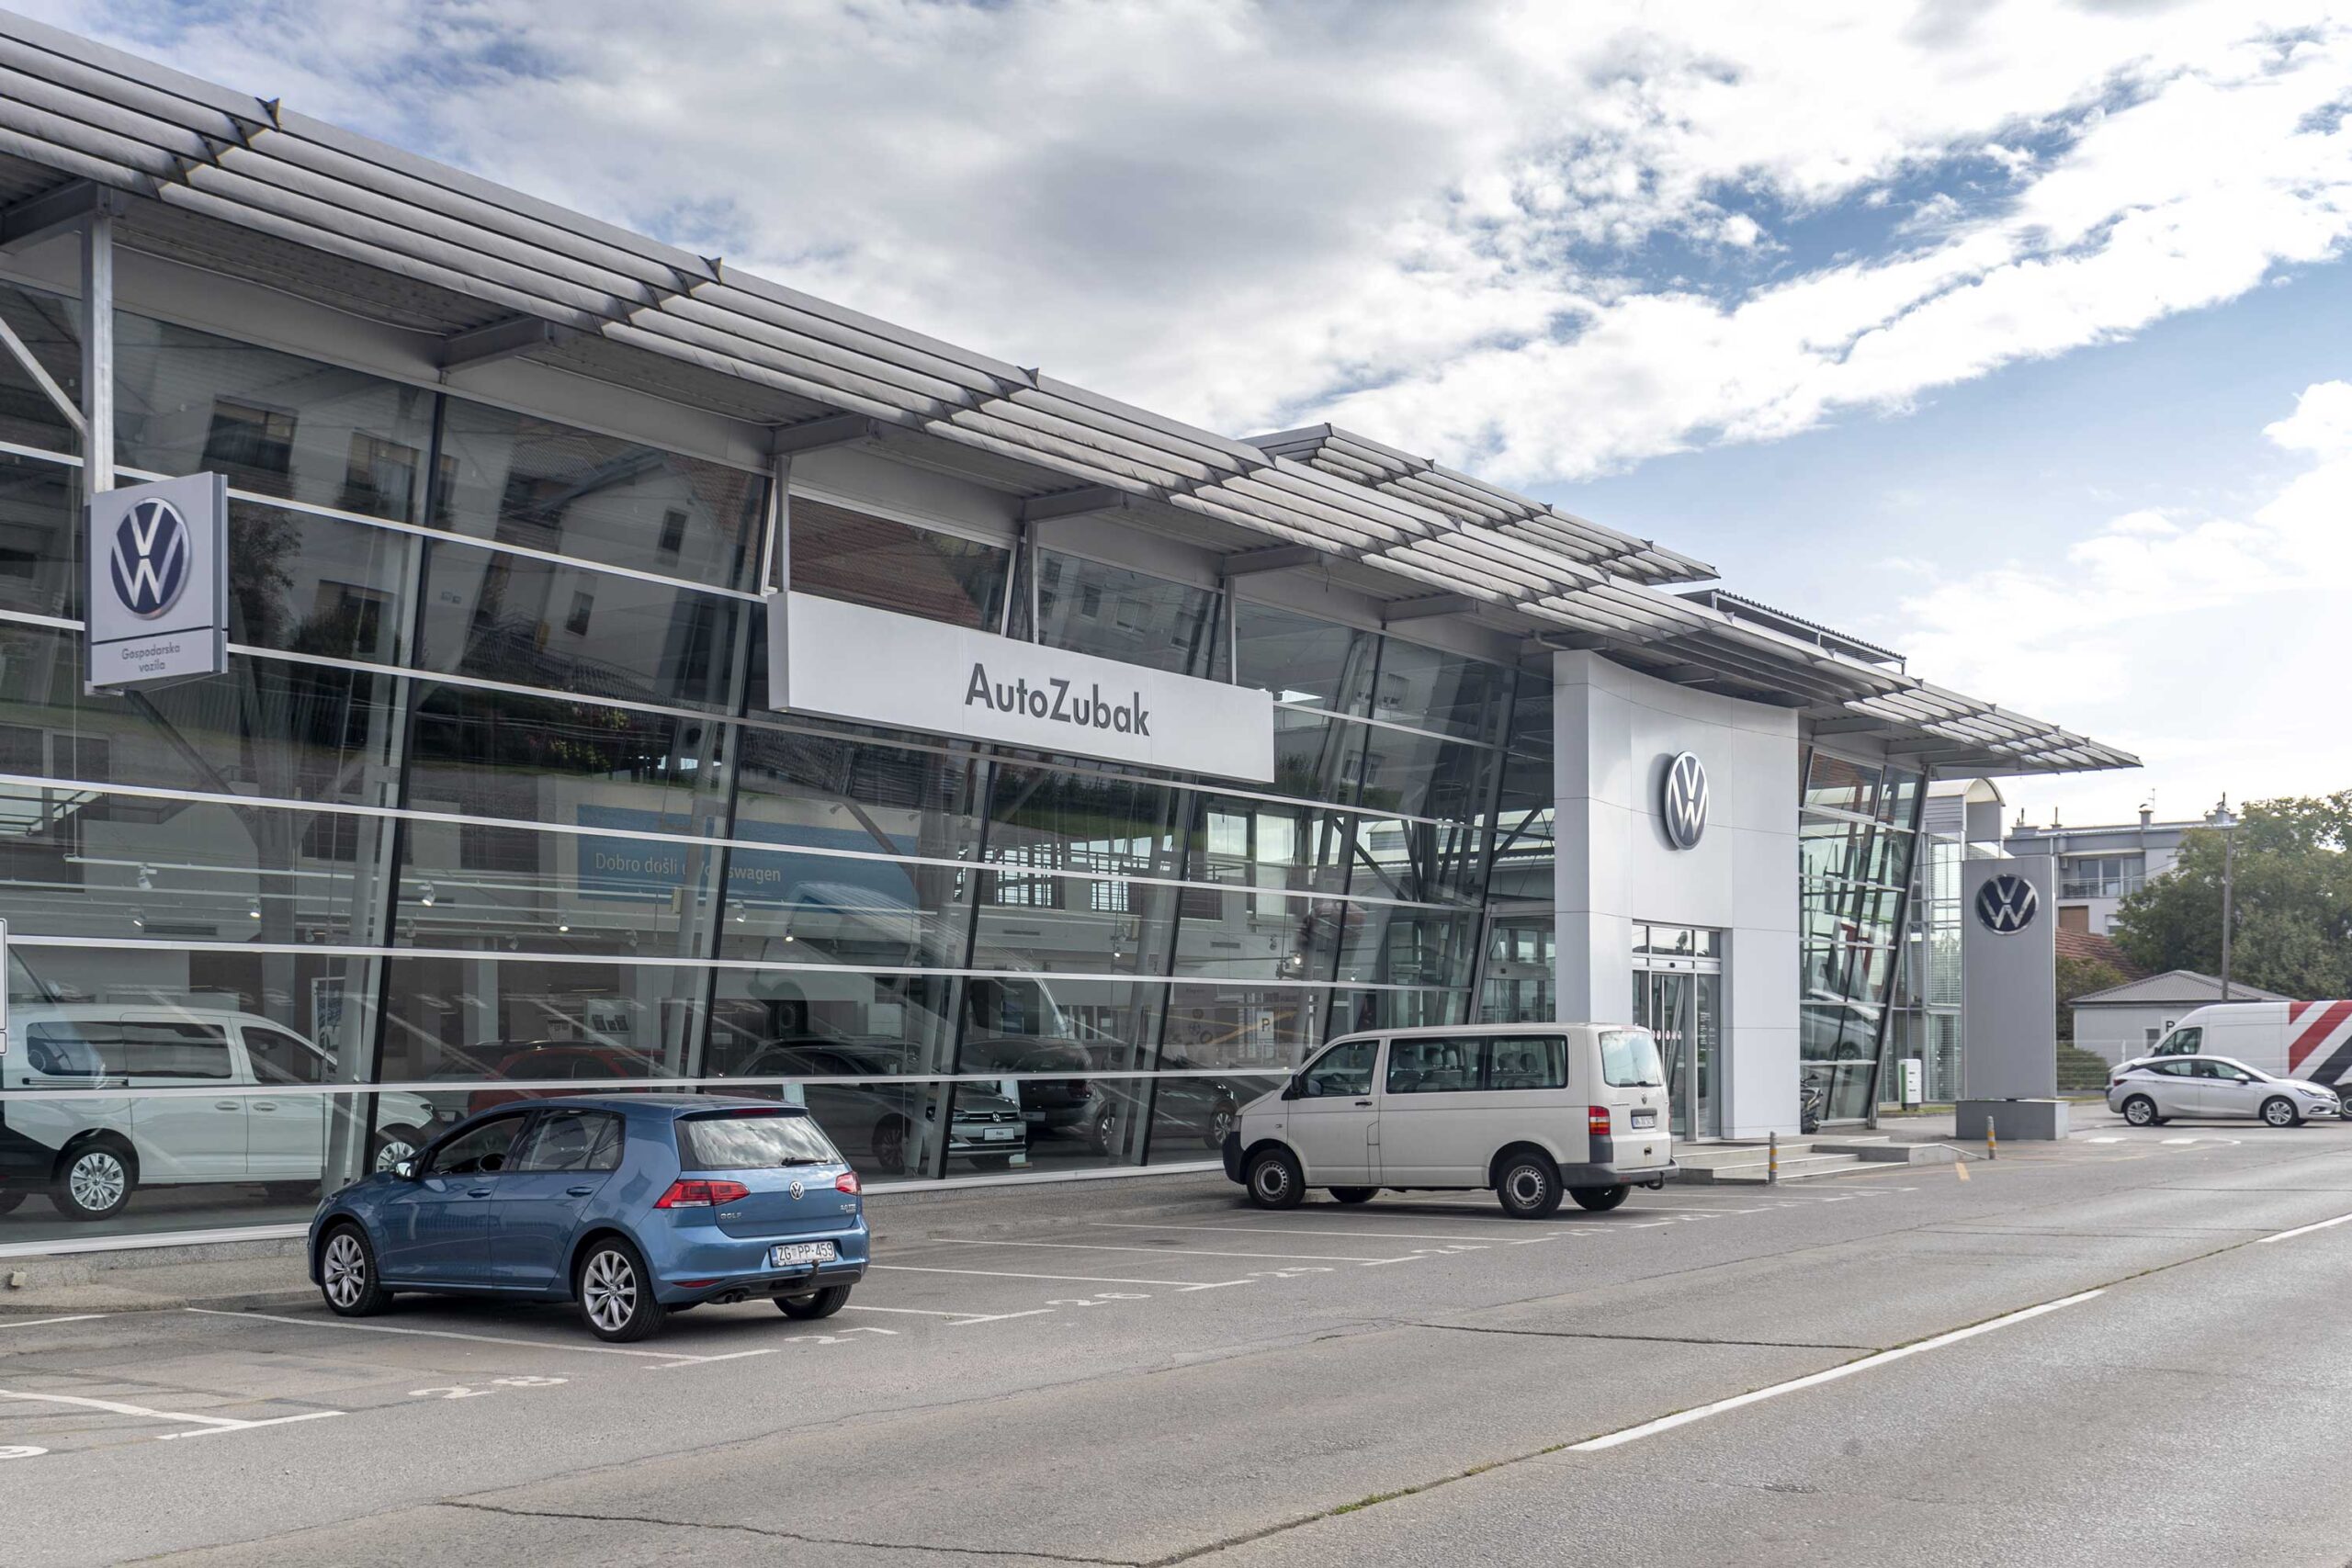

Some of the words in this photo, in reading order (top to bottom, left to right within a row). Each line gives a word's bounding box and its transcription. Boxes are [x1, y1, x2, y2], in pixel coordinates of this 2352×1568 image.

[111, 499, 189, 610] VW
[121, 642, 181, 660] Gospodarska
[139, 660, 165, 672] vozila
[965, 662, 1150, 736] AutoZubak
[1668, 753, 1709, 841] VW
[595, 852, 640, 872] Dobro
[644, 855, 677, 874] došli
[1978, 875, 2037, 930] VW
[1261, 1017, 1271, 1032] P
[778, 1247, 792, 1261] ZG
[1045, 1292, 1152, 1306] 26
[408, 1375, 570, 1399] 28
